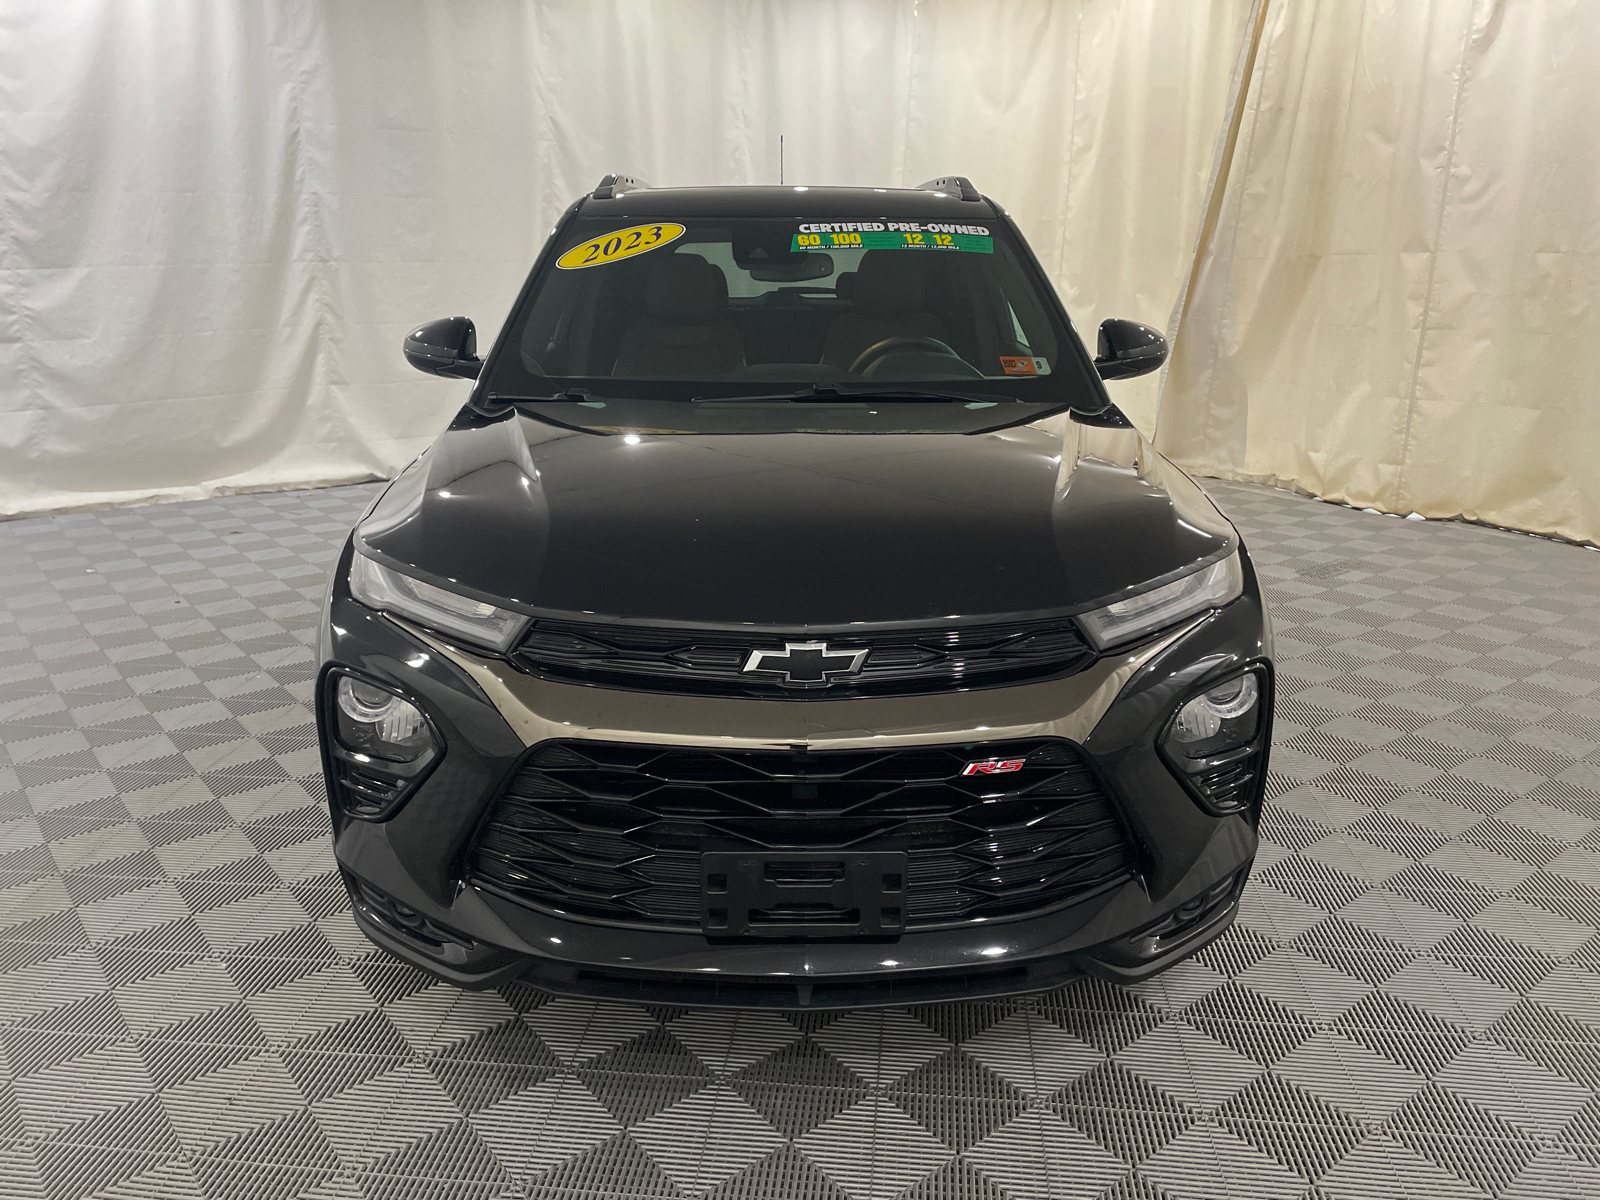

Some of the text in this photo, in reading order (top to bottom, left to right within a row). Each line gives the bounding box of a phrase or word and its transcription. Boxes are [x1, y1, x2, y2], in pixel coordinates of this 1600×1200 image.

[799, 222, 990, 236] CERTIFIED PRE-OWNED
[581, 226, 663, 264] 2023
[797, 234, 821, 246] 60
[829, 233, 862, 244] 100
[903, 233, 925, 244] 12
[932, 234, 955, 245] 12
[962, 759, 1026, 775] RS
